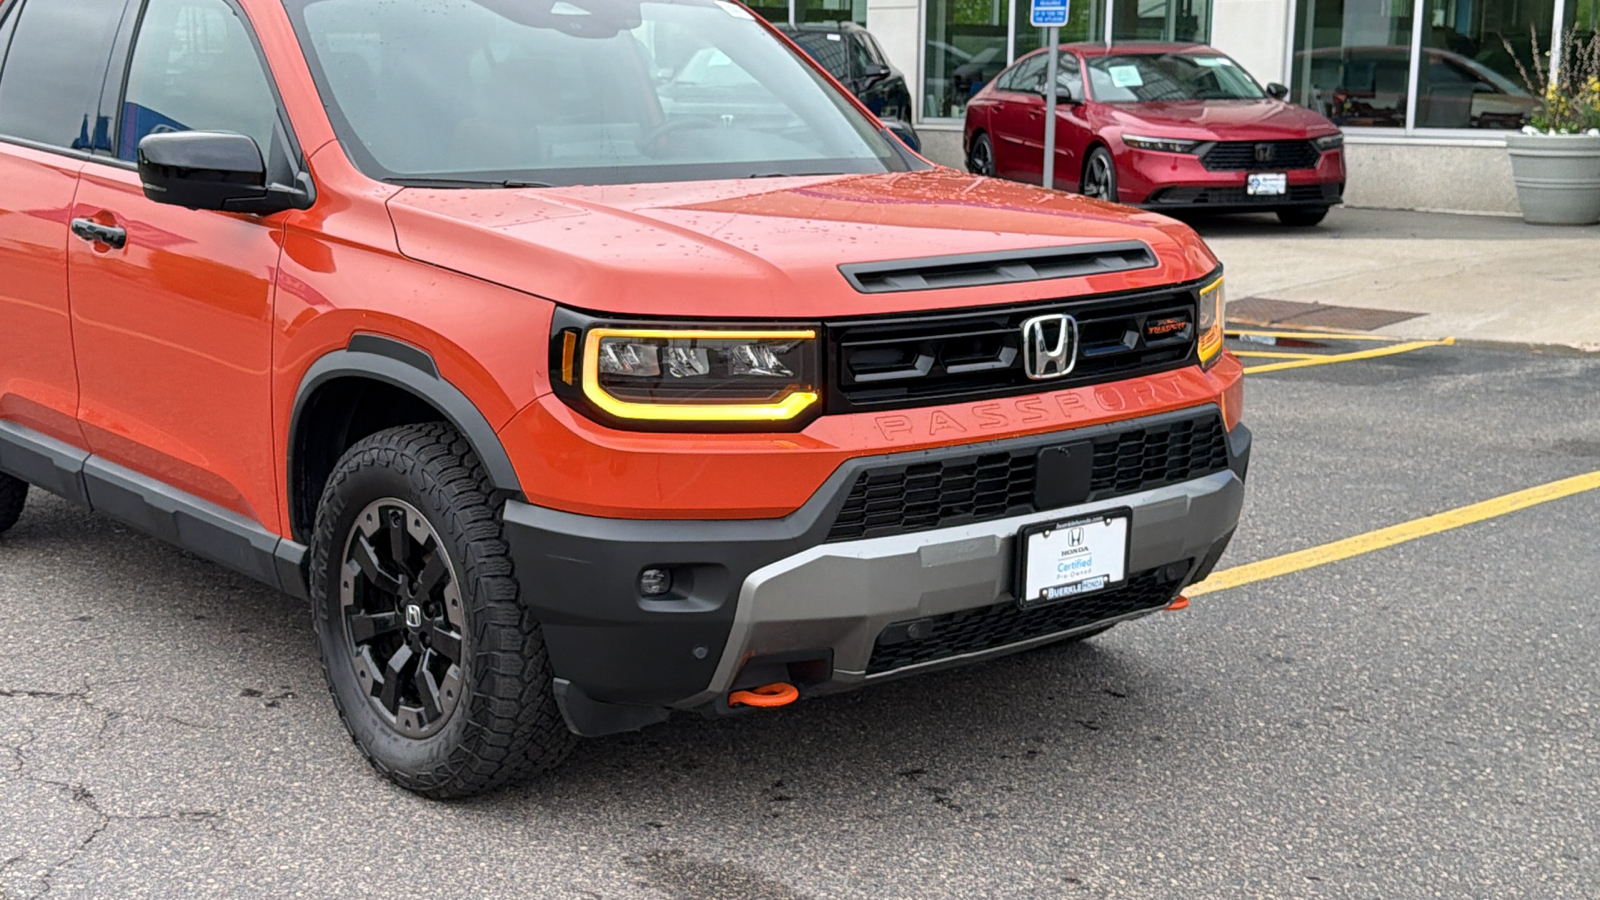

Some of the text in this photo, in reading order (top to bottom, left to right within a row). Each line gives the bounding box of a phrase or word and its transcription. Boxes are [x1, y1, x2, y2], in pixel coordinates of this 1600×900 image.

[874, 375, 1183, 441] PASSPORT
[1061, 546, 1089, 556] HONDA
[1057, 557, 1093, 573] Certified
